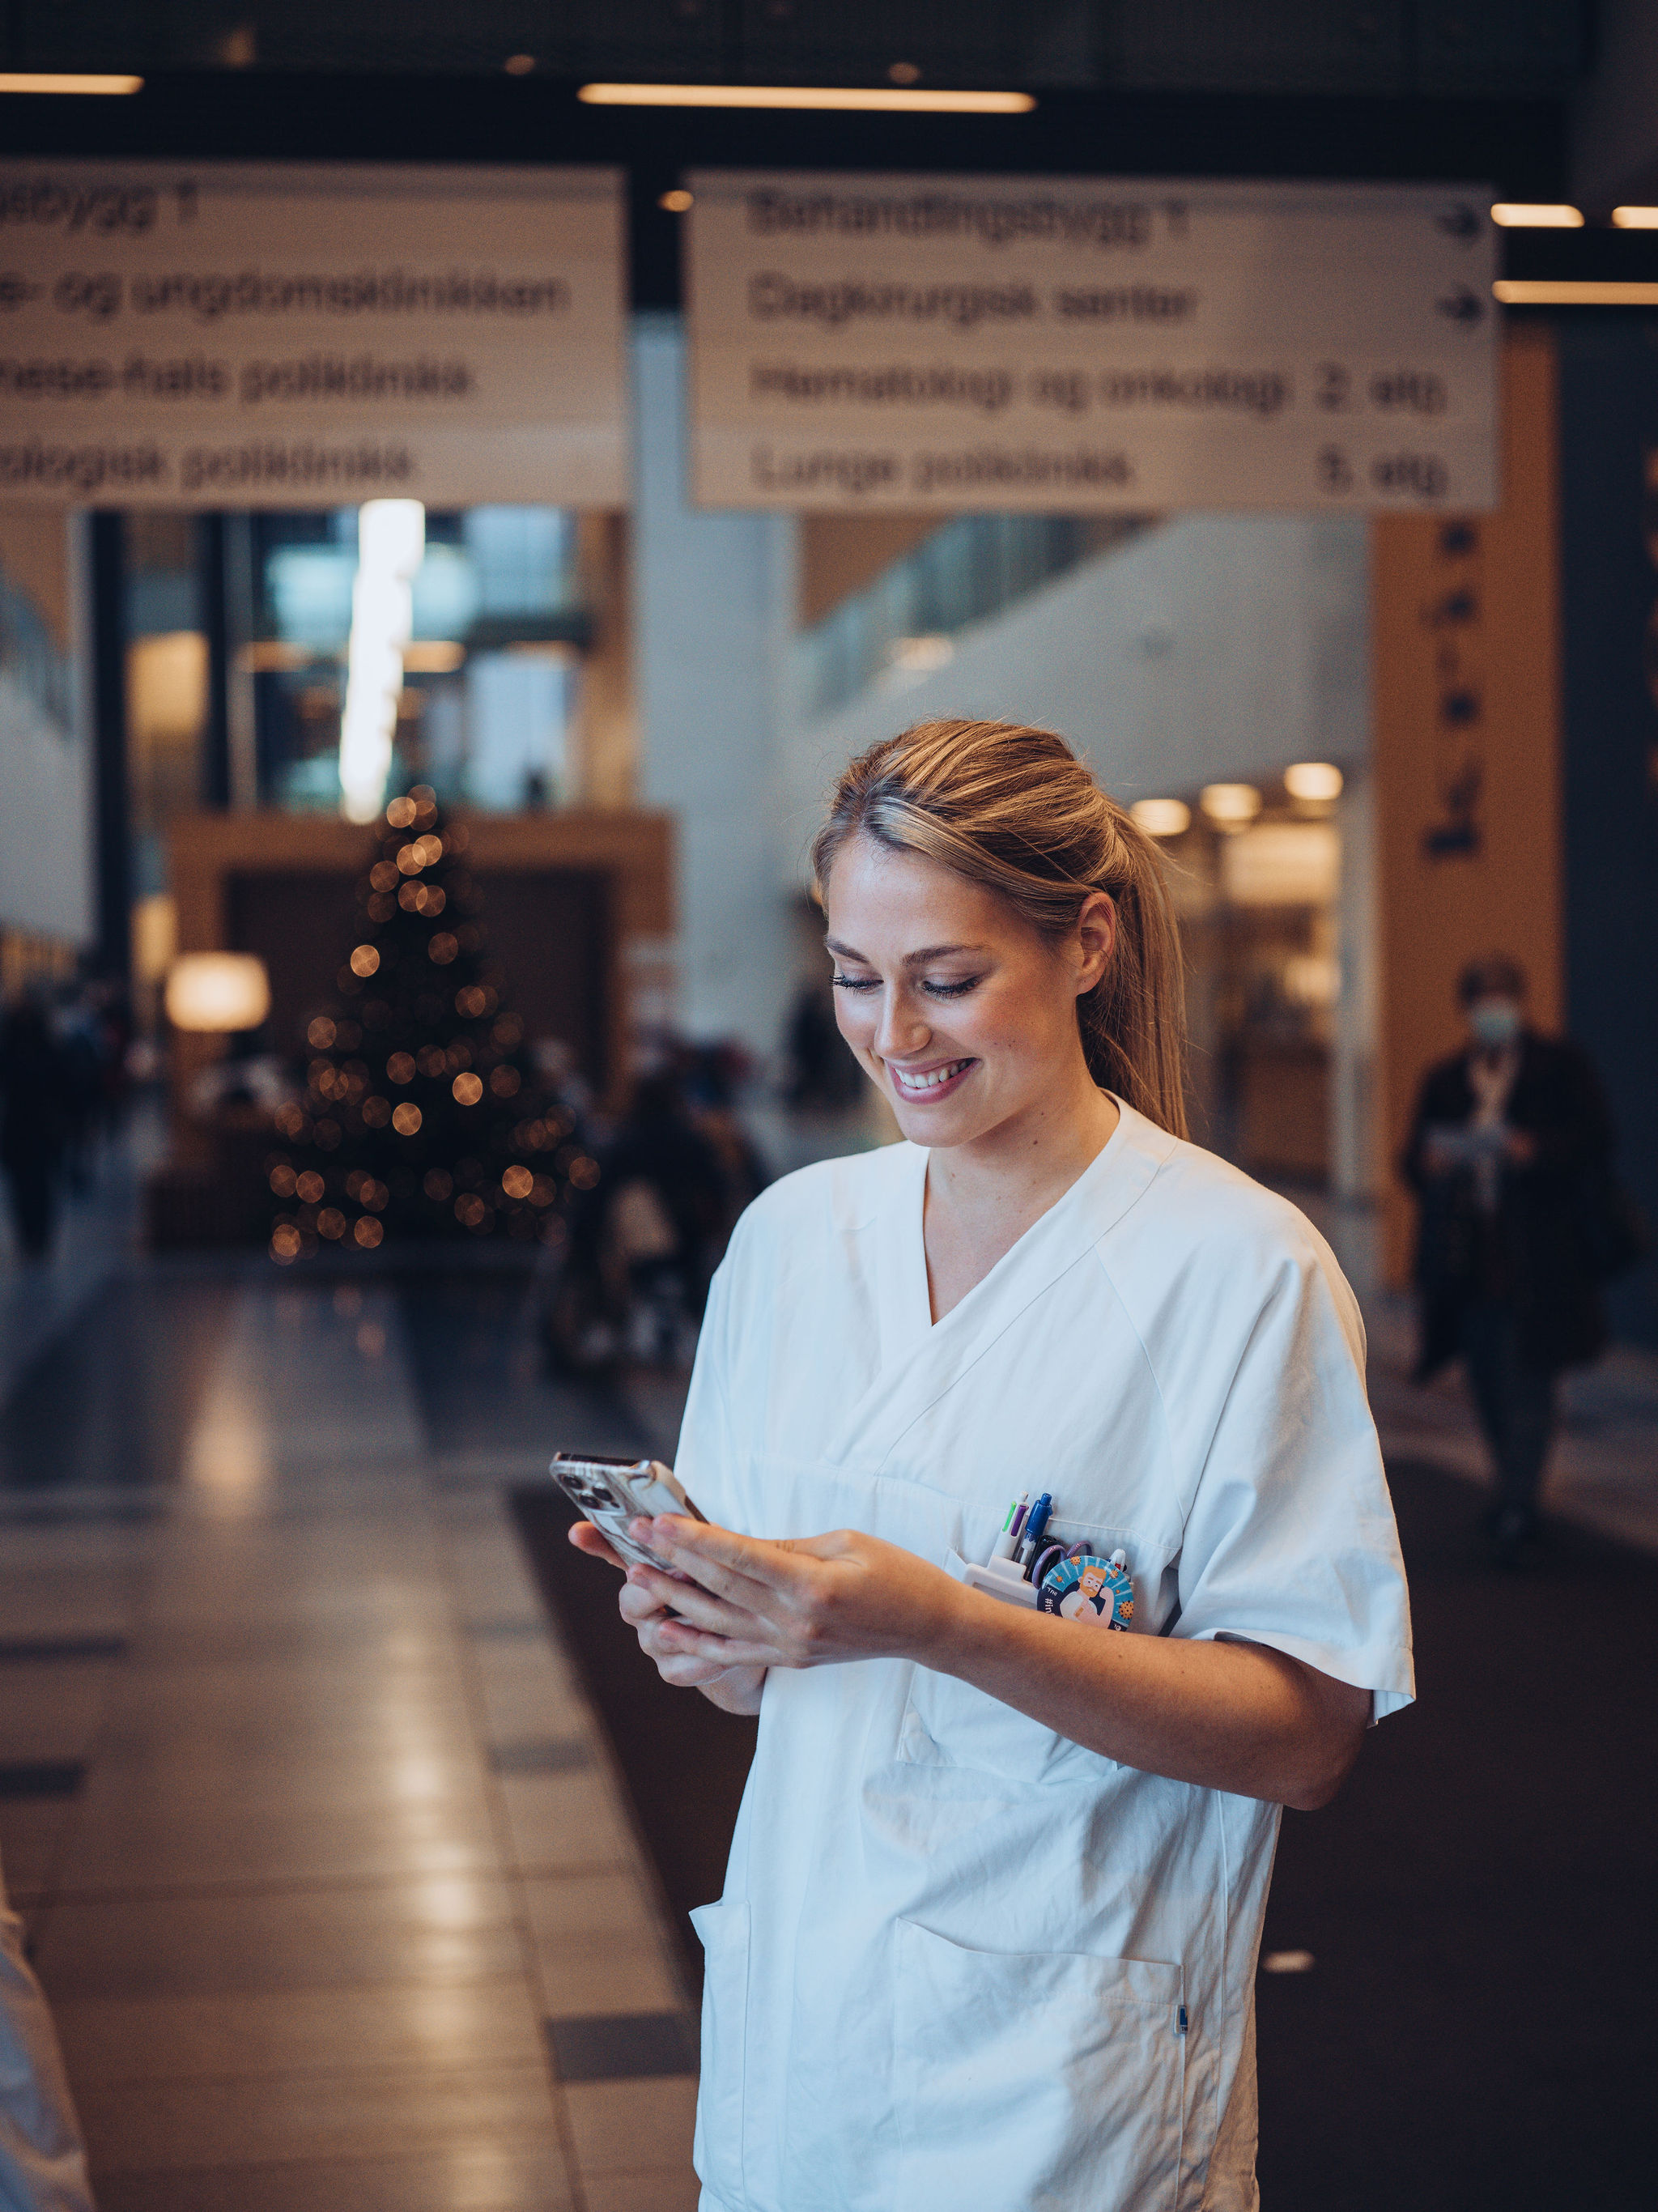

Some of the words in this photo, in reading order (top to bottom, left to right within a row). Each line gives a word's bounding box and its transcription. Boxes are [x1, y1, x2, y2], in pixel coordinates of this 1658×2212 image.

[172, 179, 198, 224] 1
[746, 188, 1150, 249] Behandlingsbygg
[1166, 197, 1191, 237] 1
[53, 270, 122, 325] og
[131, 266, 570, 324] ungdomsklinikken
[748, 271, 1039, 331] Dagkirurgisk
[1056, 286, 1197, 319] senter
[241, 350, 476, 404] poliklinikk
[748, 362, 1012, 413] Hematologi
[1030, 368, 1086, 417] og
[1097, 367, 1287, 422] onkologi
[180, 437, 415, 491] poliklinikk
[748, 445, 897, 497] Lunge
[913, 445, 1133, 495] poliklinikk
